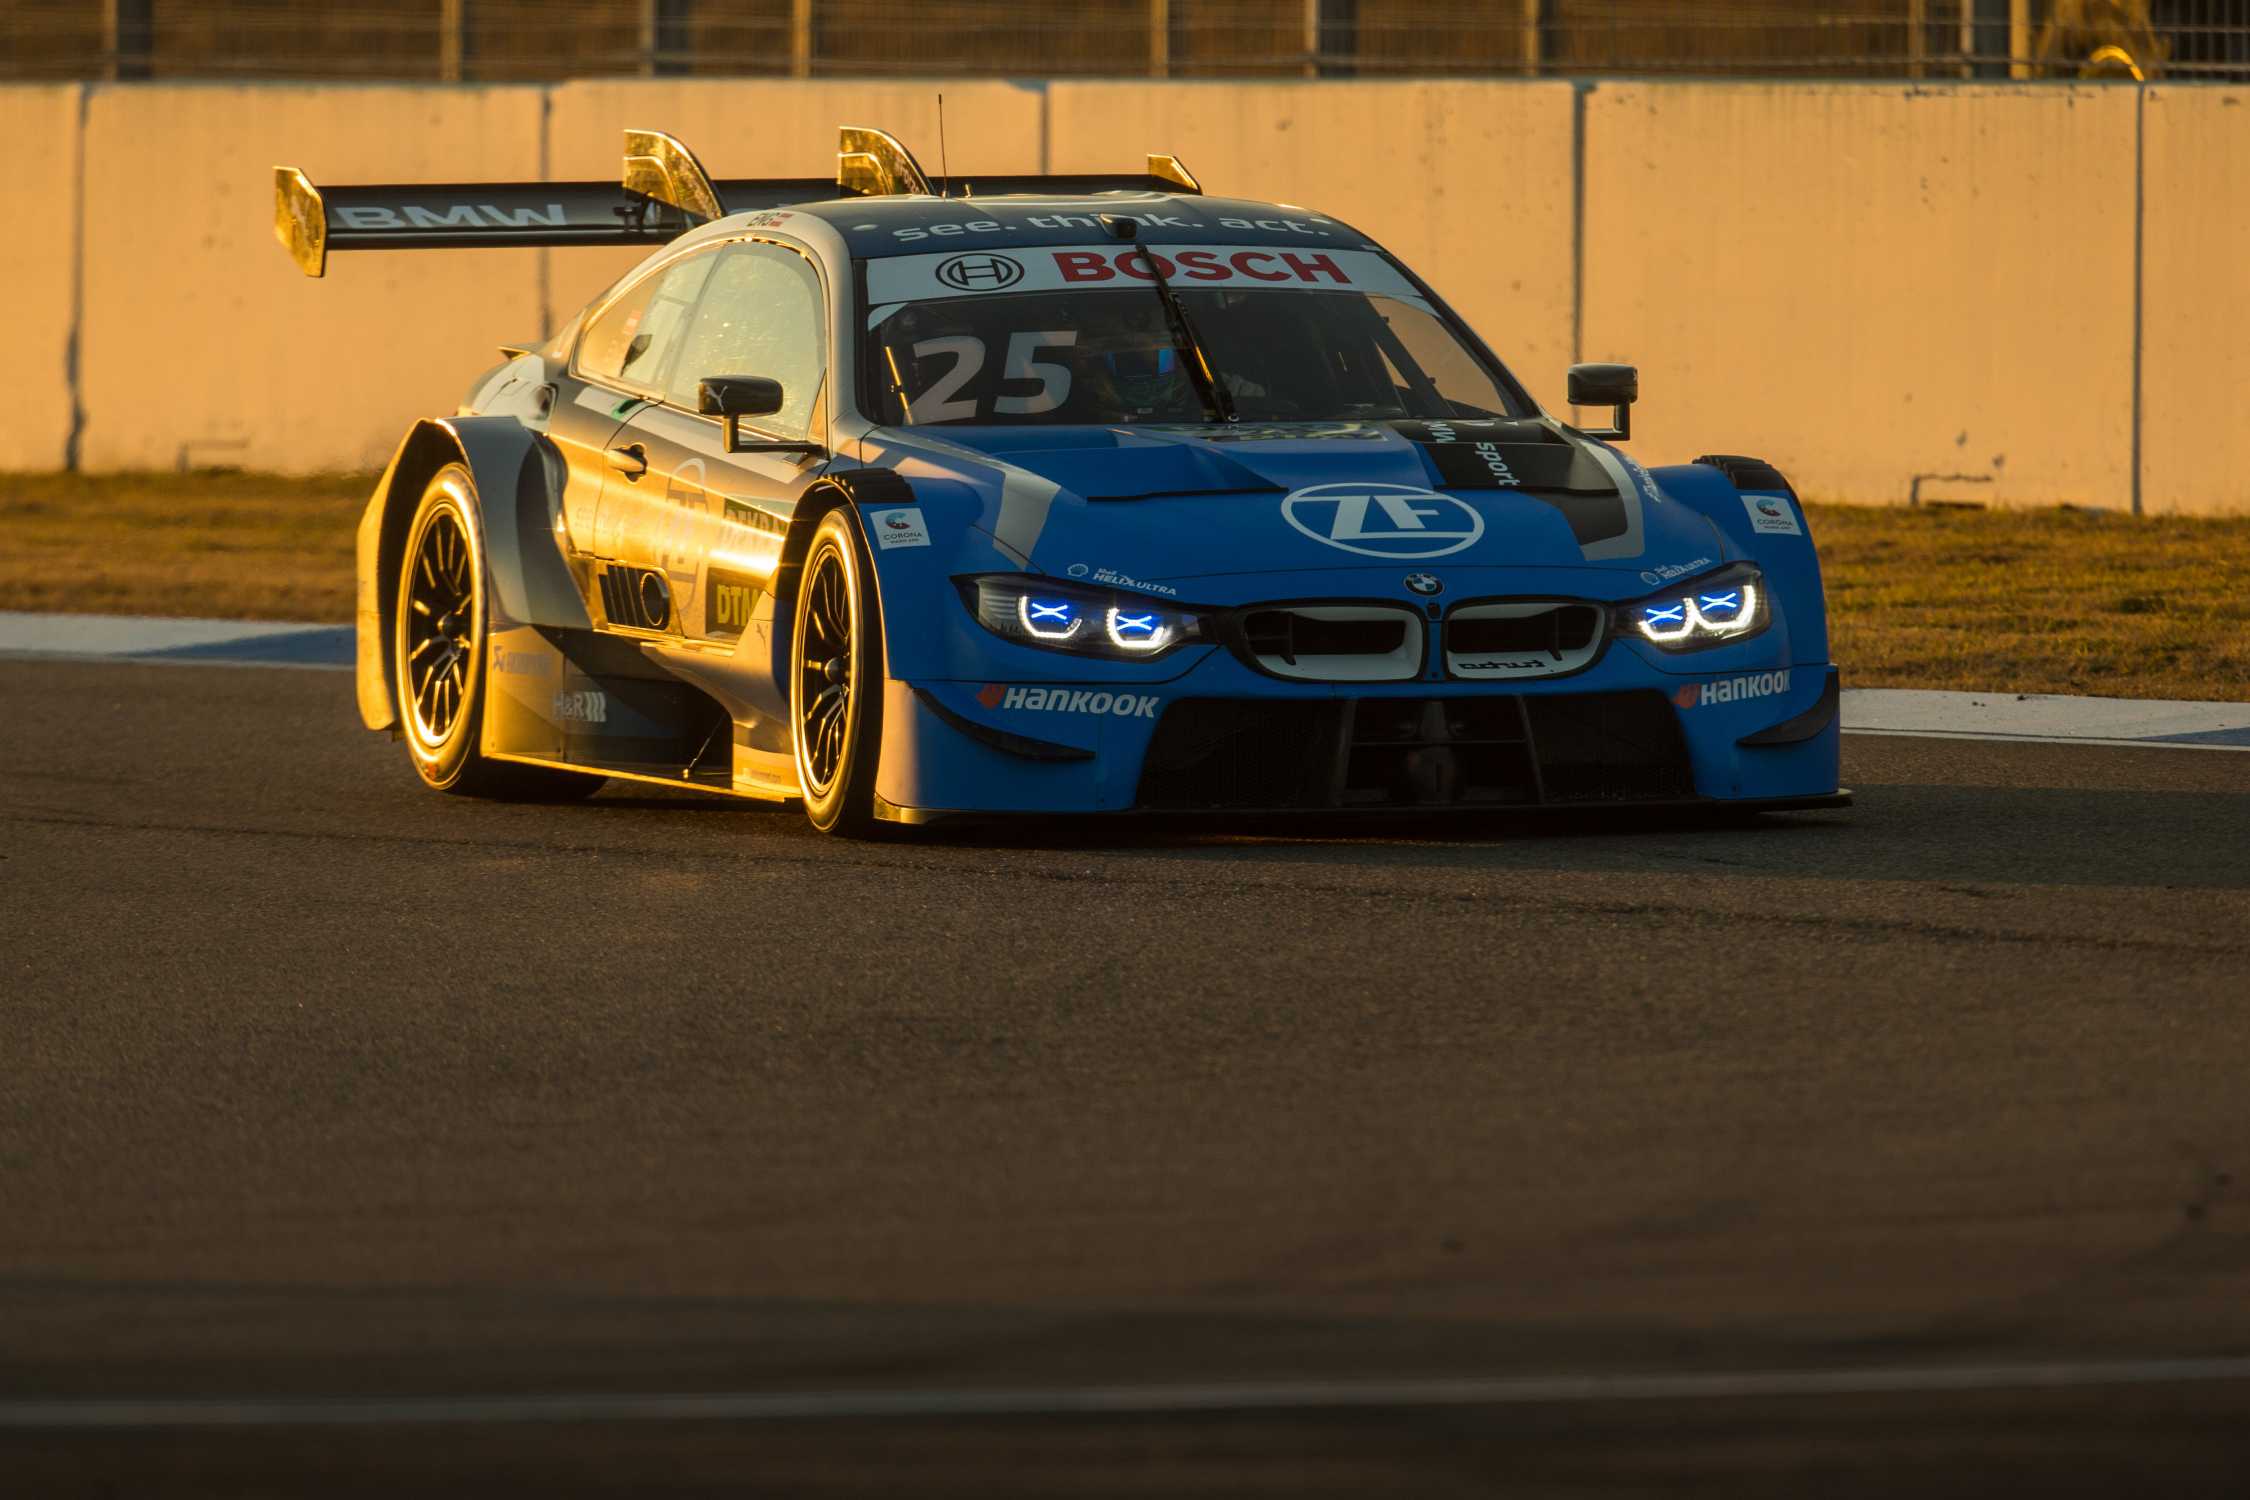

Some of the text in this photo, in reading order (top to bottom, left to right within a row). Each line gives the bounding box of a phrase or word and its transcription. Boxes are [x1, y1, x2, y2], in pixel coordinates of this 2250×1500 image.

[334, 204, 567, 229] BMW
[893, 219, 1017, 242] see.
[1218, 217, 1329, 236] act.
[1053, 251, 1352, 284] BOSCH
[903, 330, 1078, 425] 25
[1474, 441, 1520, 486] sport
[1003, 687, 1160, 718] HANKOOK
